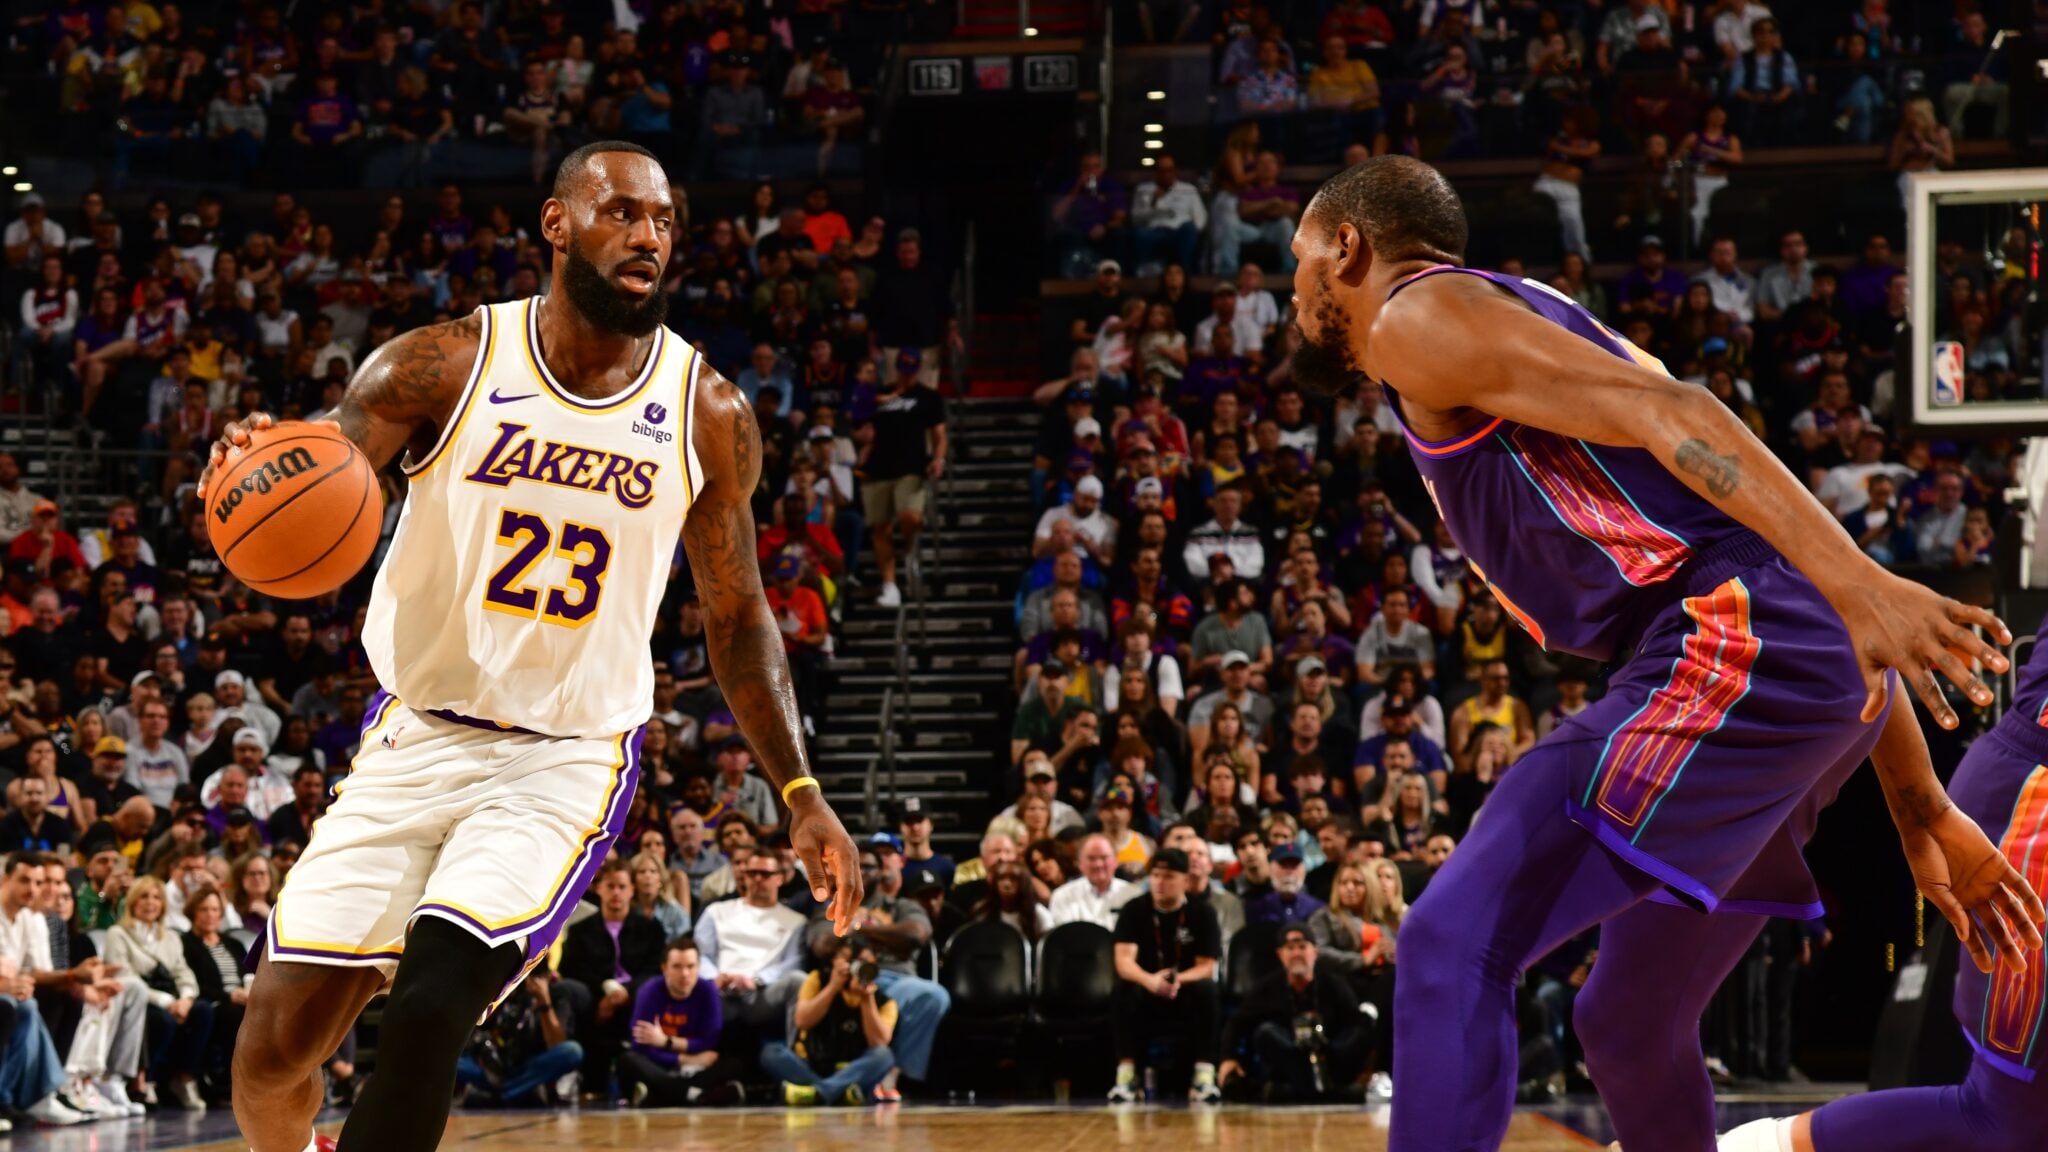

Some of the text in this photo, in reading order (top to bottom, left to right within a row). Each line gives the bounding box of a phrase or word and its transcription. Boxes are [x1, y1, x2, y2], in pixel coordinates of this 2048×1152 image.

[918, 64, 953, 90] 119
[1034, 62, 1070, 86] 120
[631, 420, 673, 444] bibigo
[215, 446, 318, 524] Wilson
[463, 420, 662, 511] LAKERS
[482, 506, 614, 629] 23
